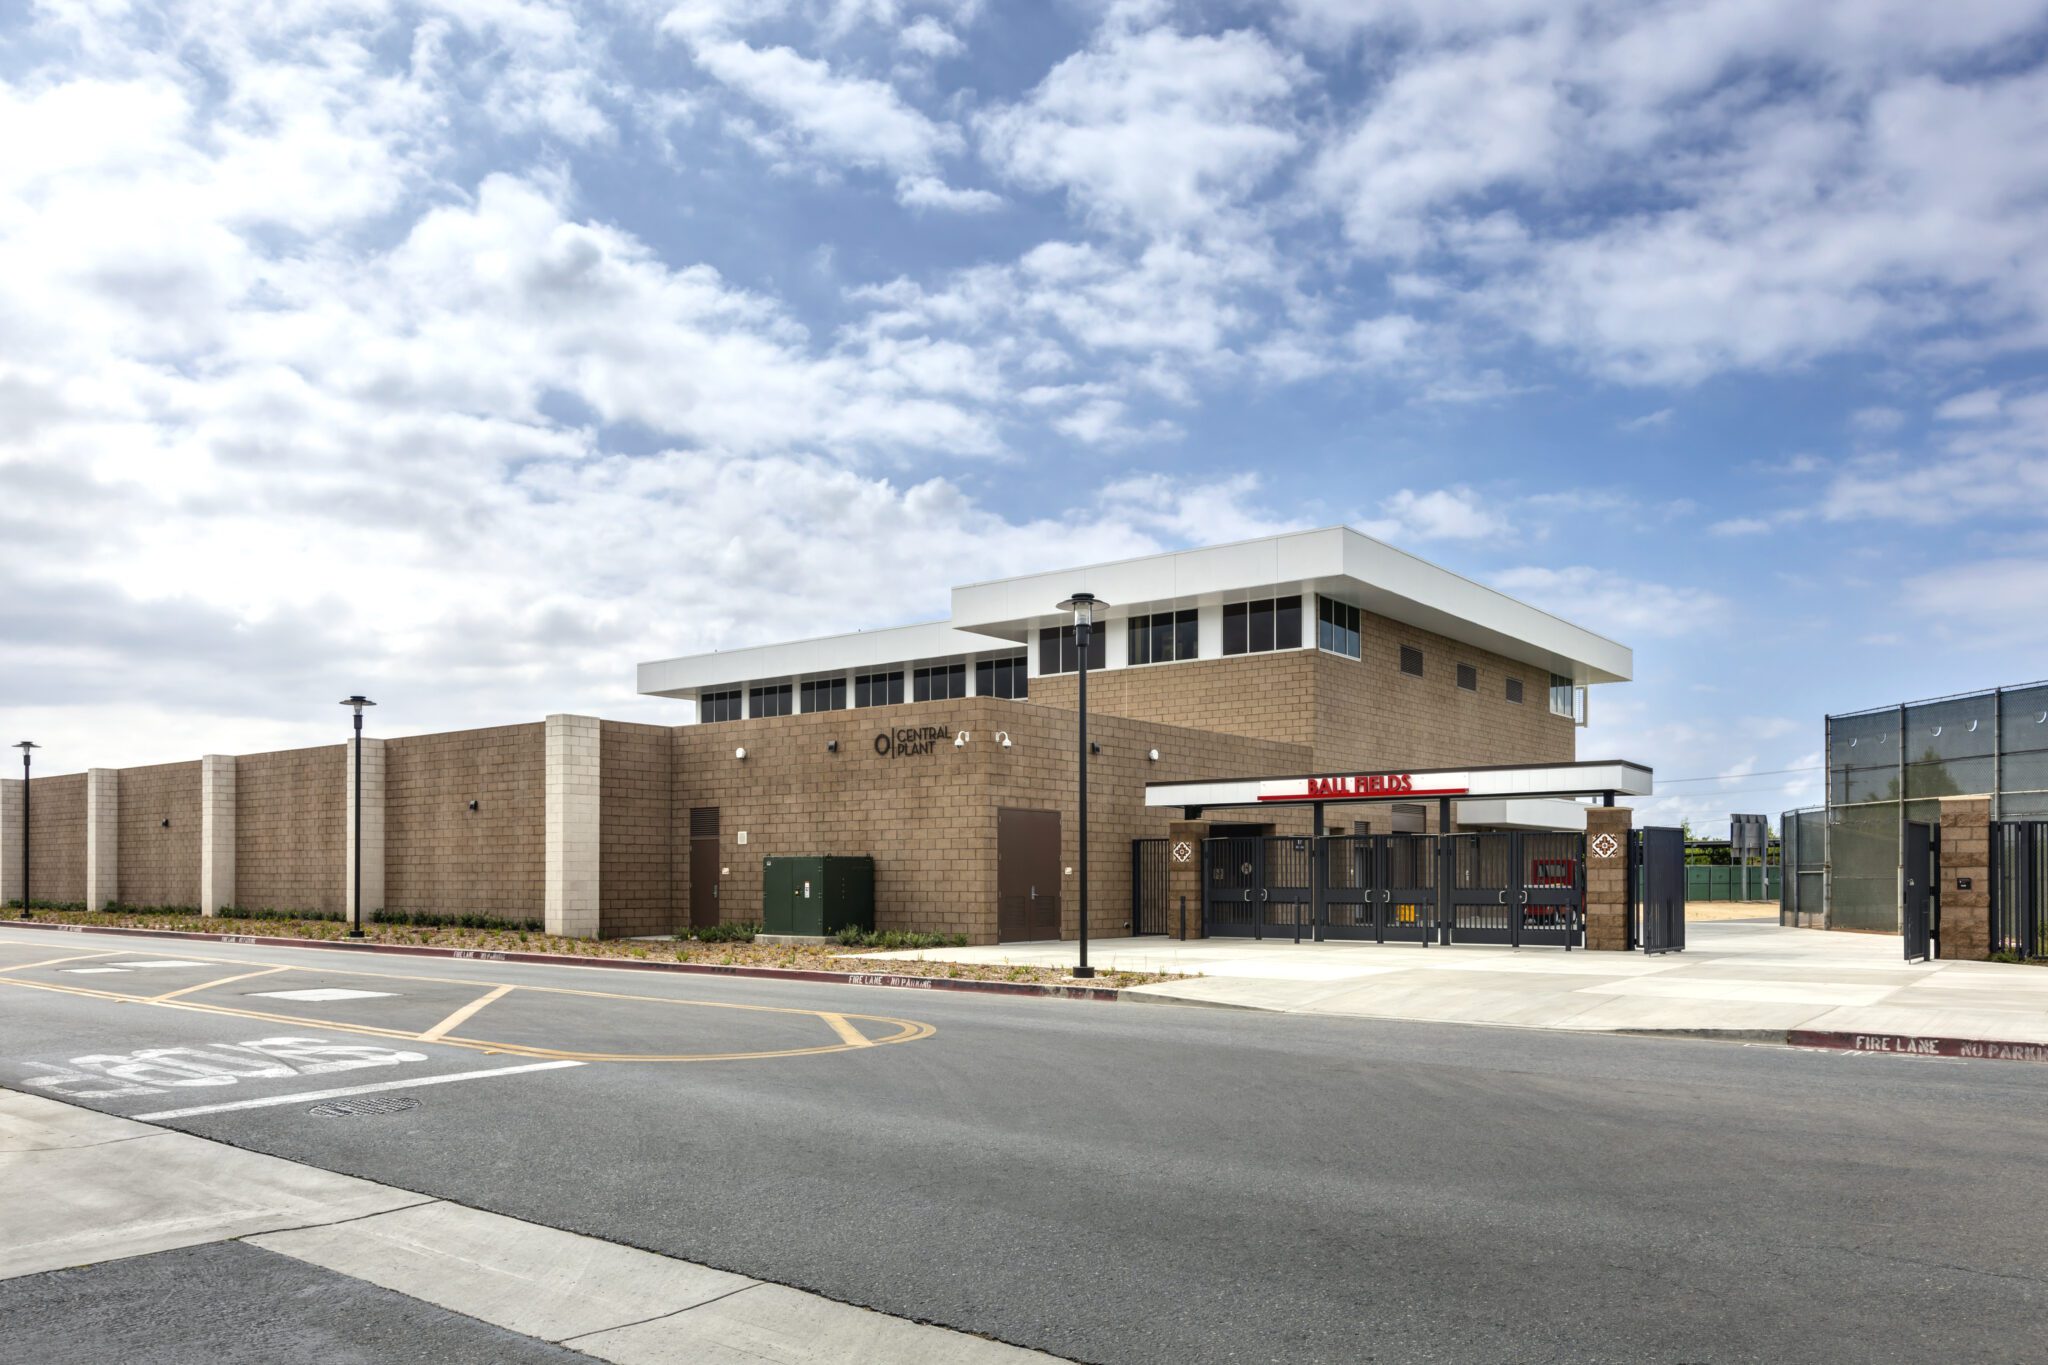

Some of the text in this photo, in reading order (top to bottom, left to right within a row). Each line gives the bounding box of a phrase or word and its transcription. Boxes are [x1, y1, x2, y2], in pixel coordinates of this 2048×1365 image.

[896, 725, 950, 743] CENTRAL
[896, 741, 936, 757] PLANT
[1307, 773, 1412, 795] BALL FIELDS
[848, 975, 863, 985] FIRE
[864, 975, 882, 985] LANE
[890, 977, 900, 986] NO
[1855, 1035, 1891, 1052] FIRE
[1896, 1038, 1940, 1054] LANE
[1960, 1042, 1984, 1057] NO
